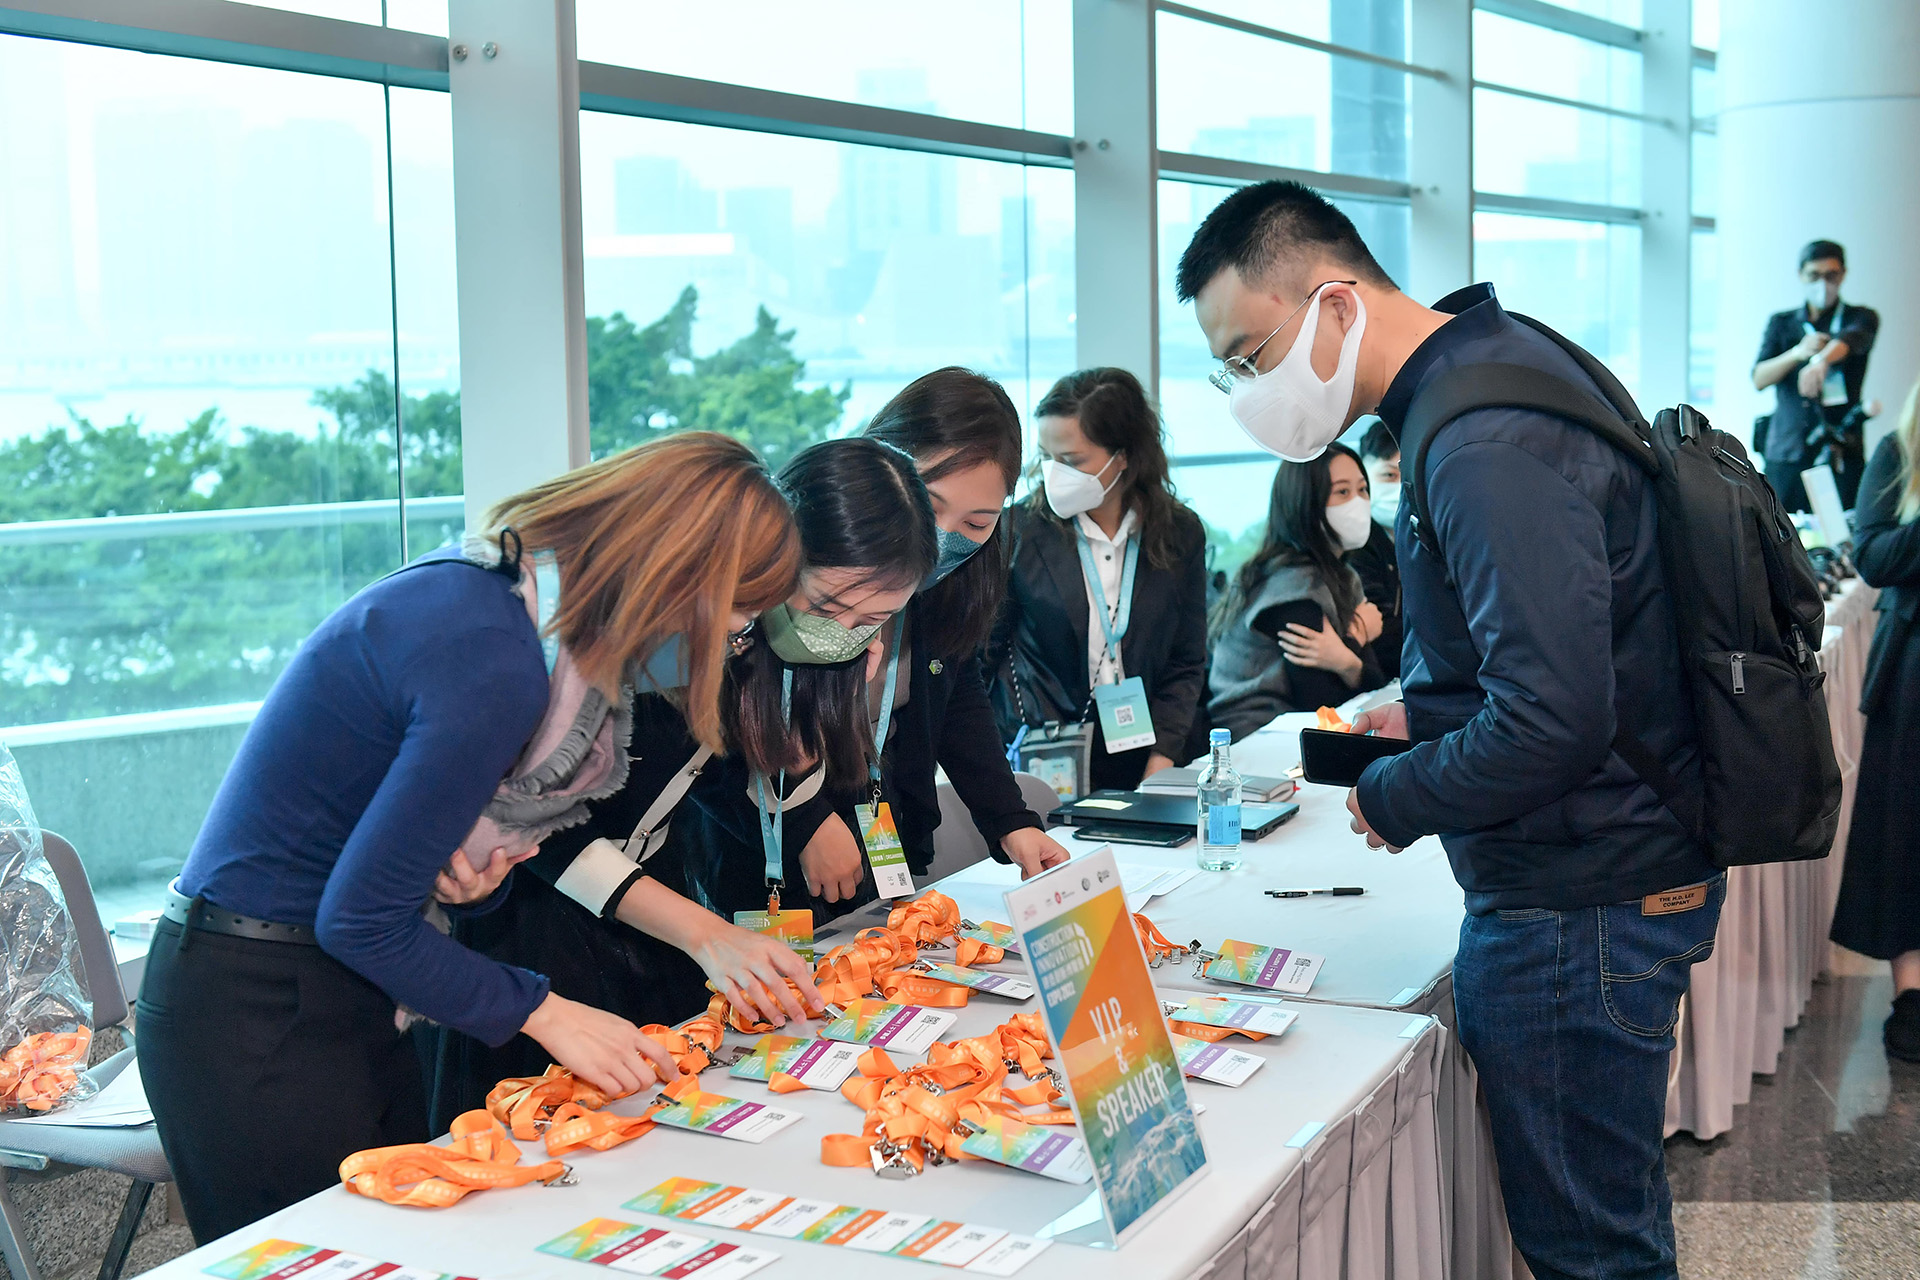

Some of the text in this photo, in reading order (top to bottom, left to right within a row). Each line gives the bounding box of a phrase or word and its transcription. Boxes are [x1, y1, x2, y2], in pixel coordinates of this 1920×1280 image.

[1662, 899, 1690, 908] COMPANY
[1030, 923, 1076, 959] CONSTRUCTION
[1035, 938, 1081, 975] INNOVATION
[1089, 996, 1122, 1045] VIP
[1115, 1045, 1130, 1075] &
[1096, 1062, 1170, 1138] SPEAKER
